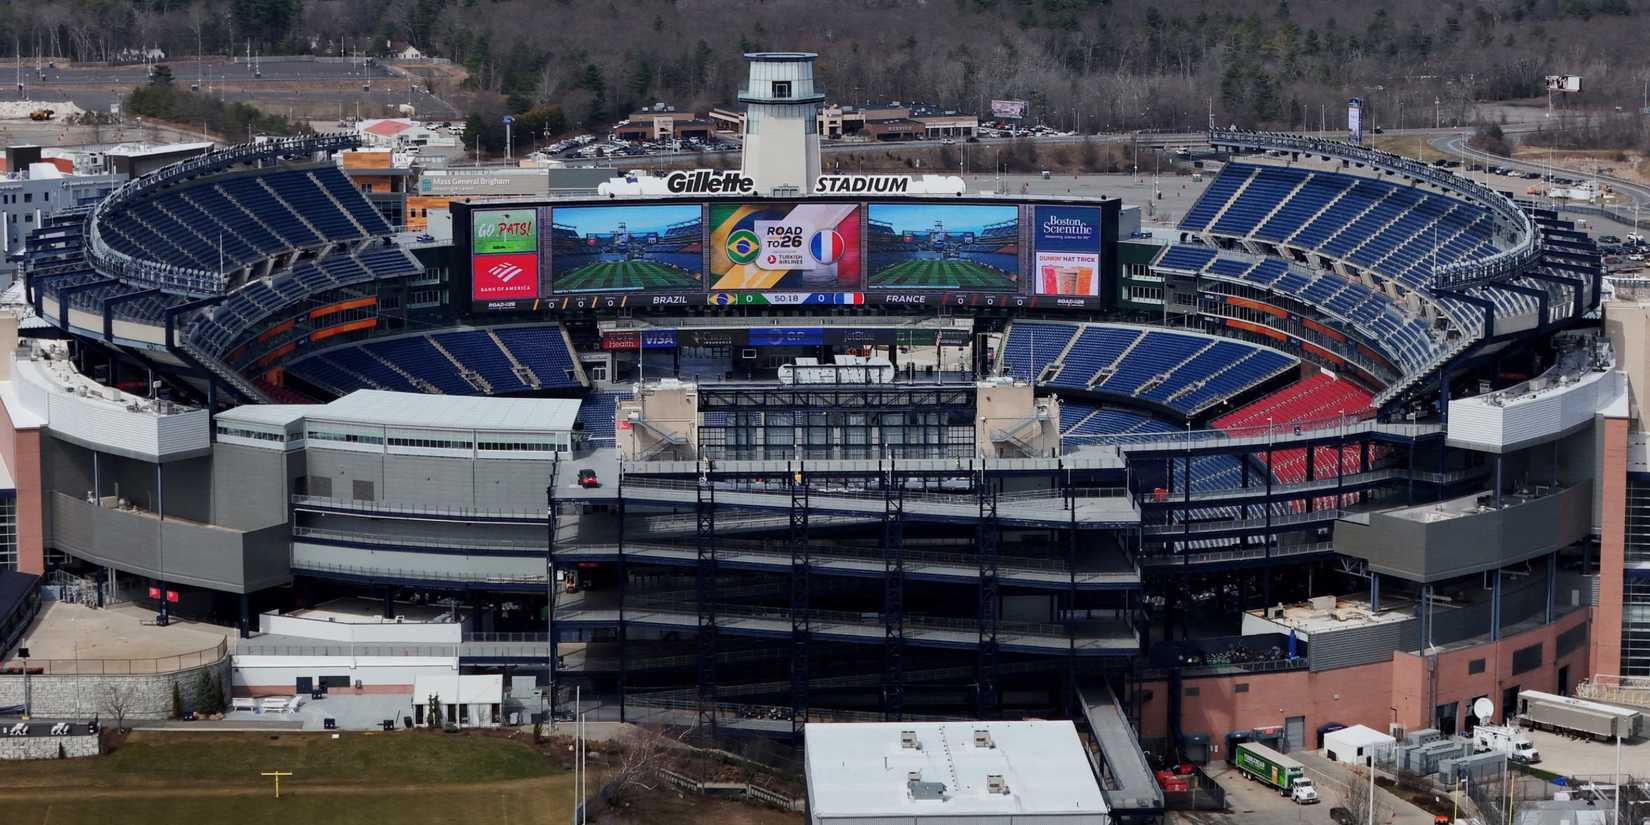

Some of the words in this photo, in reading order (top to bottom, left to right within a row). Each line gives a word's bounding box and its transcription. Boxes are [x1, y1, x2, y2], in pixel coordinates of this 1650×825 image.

[480, 177, 510, 186] Brigham
[668, 172, 754, 194] Gillette
[816, 176, 908, 192] STADIUM
[1050, 216, 1080, 226] Boston
[479, 224, 494, 238] GO
[498, 221, 532, 238] PATS!
[768, 226, 802, 235] ROAD
[1044, 222, 1092, 234] Scientific
[780, 236, 802, 248] 26
[653, 296, 687, 304] BRAZIL
[609, 340, 634, 348] Health
